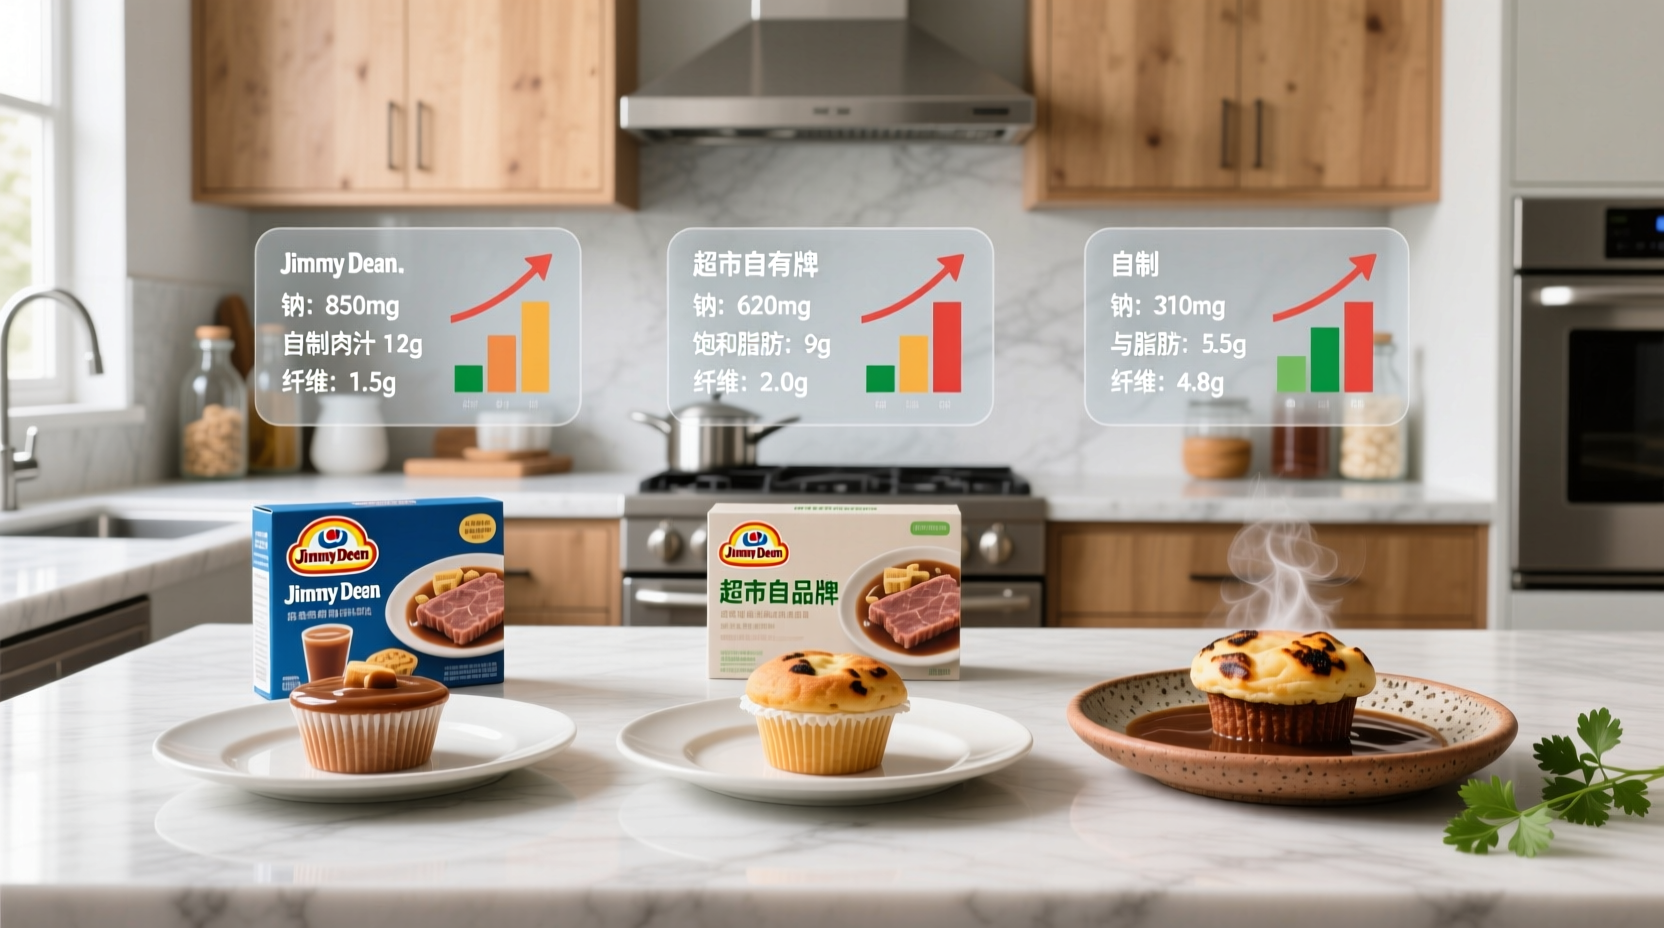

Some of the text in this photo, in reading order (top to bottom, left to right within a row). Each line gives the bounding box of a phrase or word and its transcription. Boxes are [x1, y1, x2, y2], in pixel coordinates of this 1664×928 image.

[340, 582, 381, 601] Dean
[720, 579, 839, 605] 超市自品牌
